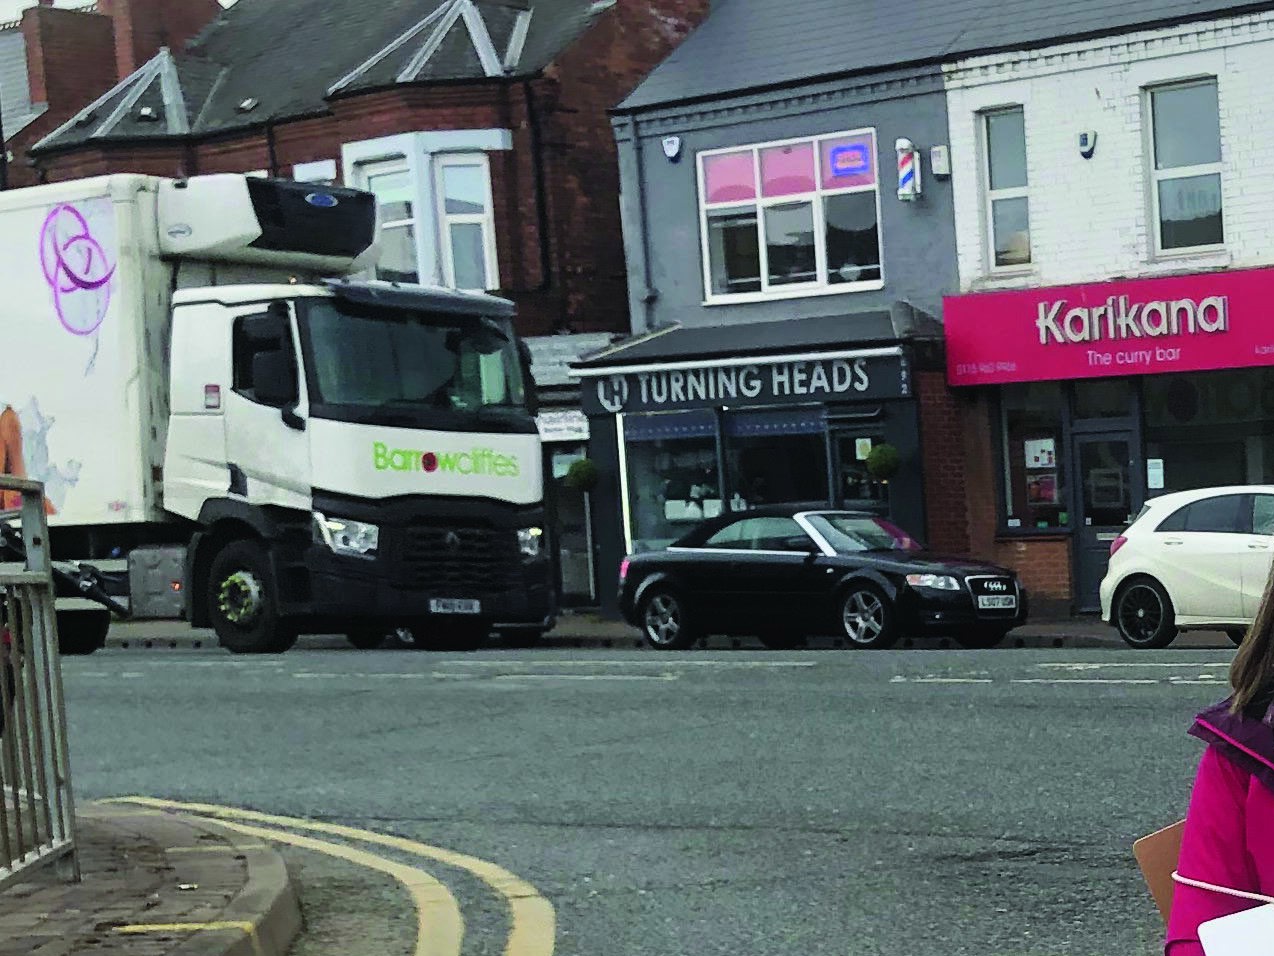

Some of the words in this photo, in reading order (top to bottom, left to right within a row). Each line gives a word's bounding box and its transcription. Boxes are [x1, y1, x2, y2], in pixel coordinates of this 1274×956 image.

[1035, 295, 1229, 344] Karikana
[1087, 350, 1112, 366] The
[1116, 349, 1151, 367] curry
[1156, 346, 1180, 362] bar
[639, 366, 762, 404] TURNING
[771, 359, 869, 396] HEADS
